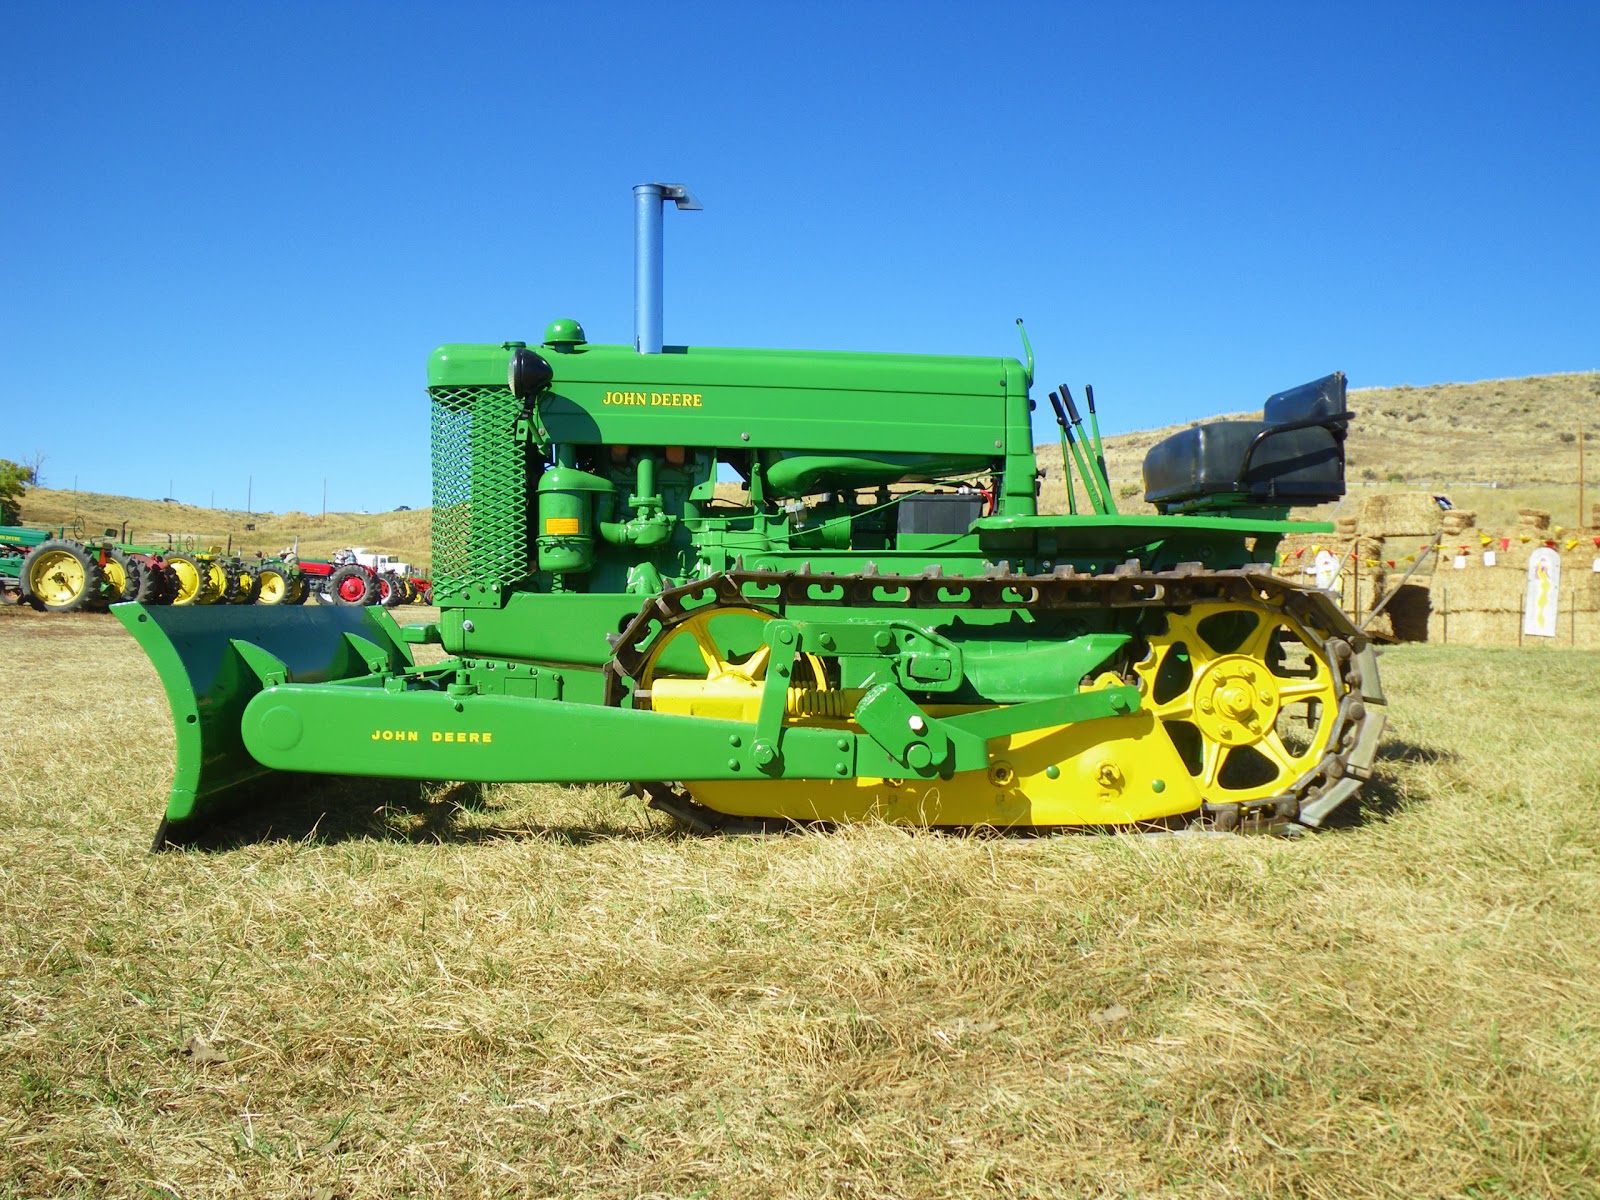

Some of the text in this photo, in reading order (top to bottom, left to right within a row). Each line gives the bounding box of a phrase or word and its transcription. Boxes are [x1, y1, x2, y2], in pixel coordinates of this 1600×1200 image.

[603, 392, 703, 406] JOHN DEERE
[371, 730, 492, 743] JOHN DEERE
